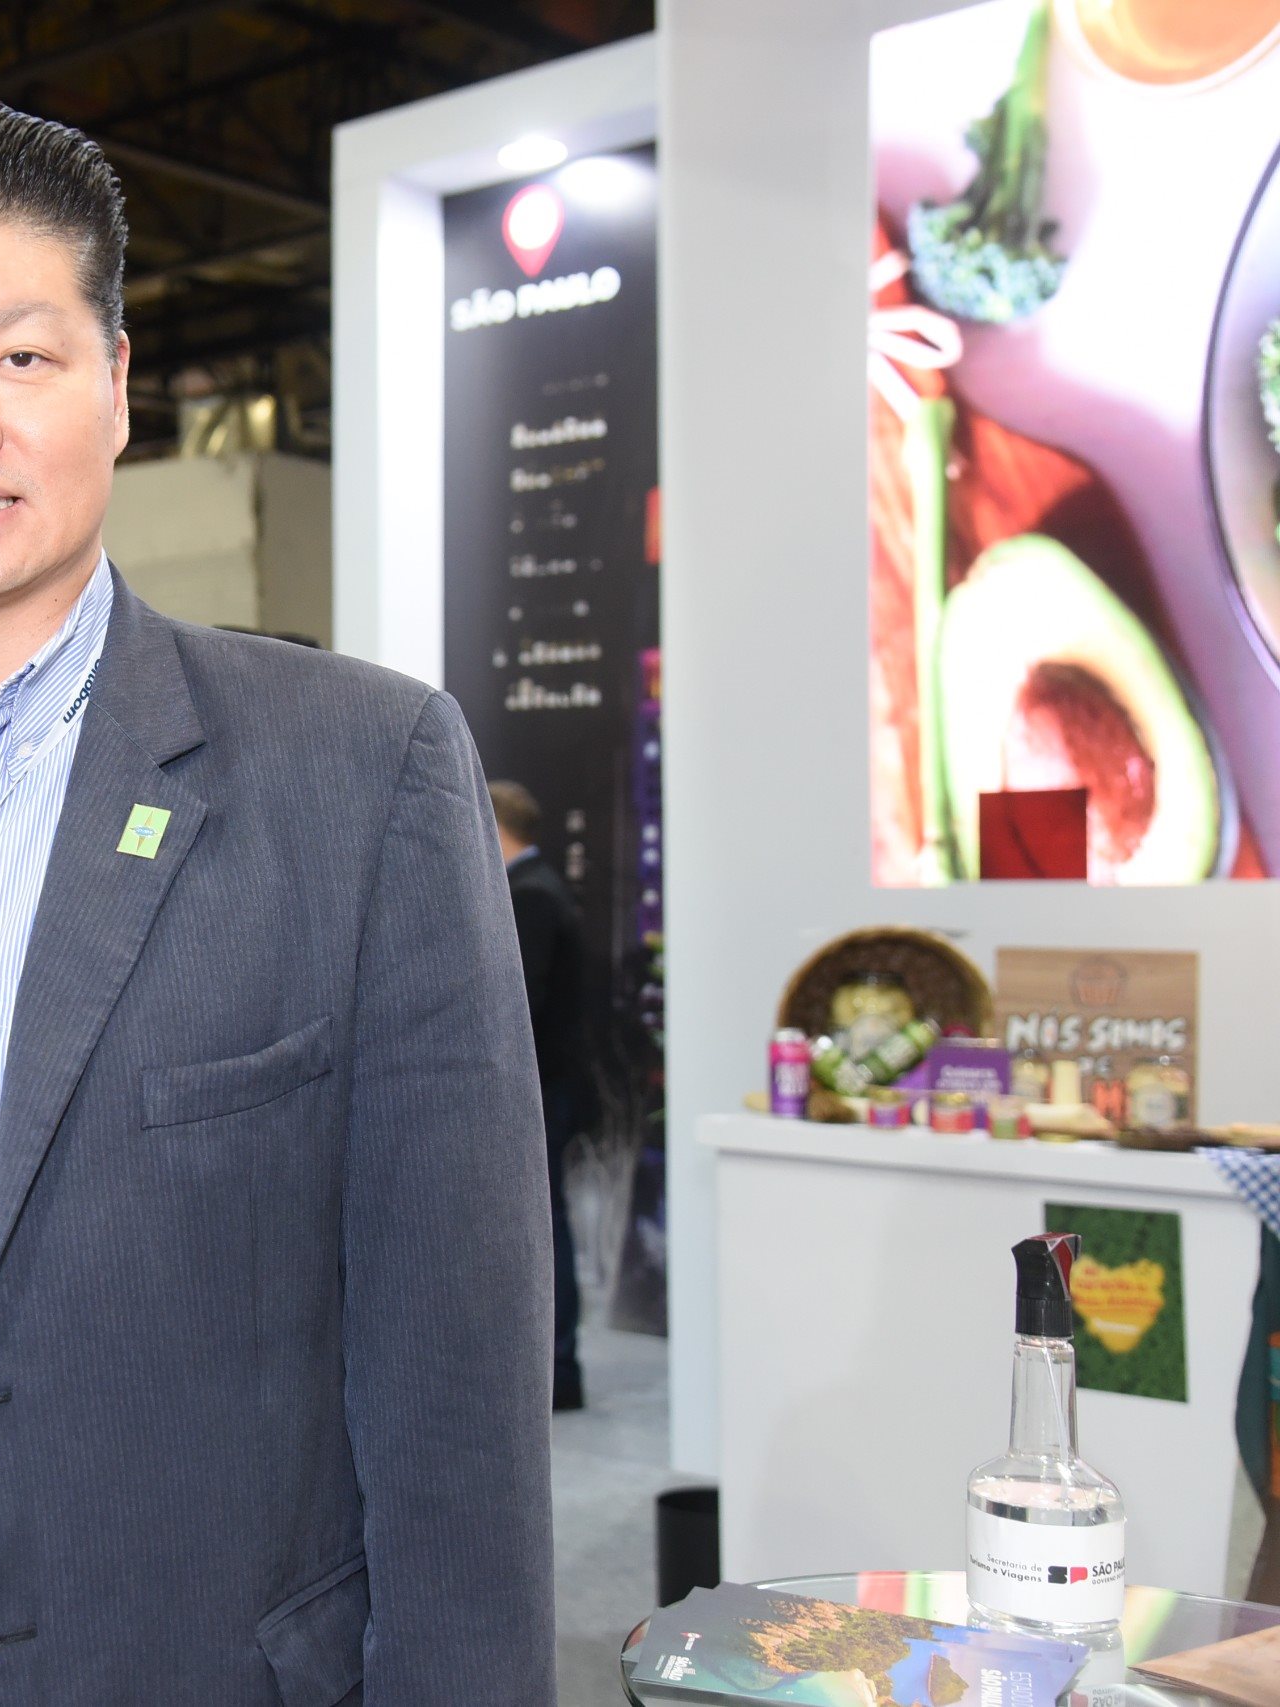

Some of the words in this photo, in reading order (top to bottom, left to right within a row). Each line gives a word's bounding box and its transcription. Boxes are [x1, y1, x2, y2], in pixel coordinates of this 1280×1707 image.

[986, 1553, 1028, 1571] Secretaria
[1030, 1563, 1042, 1572] de
[1092, 1561, 1112, 1578] SÃO
[1000, 1568, 1042, 1583] Viagens
